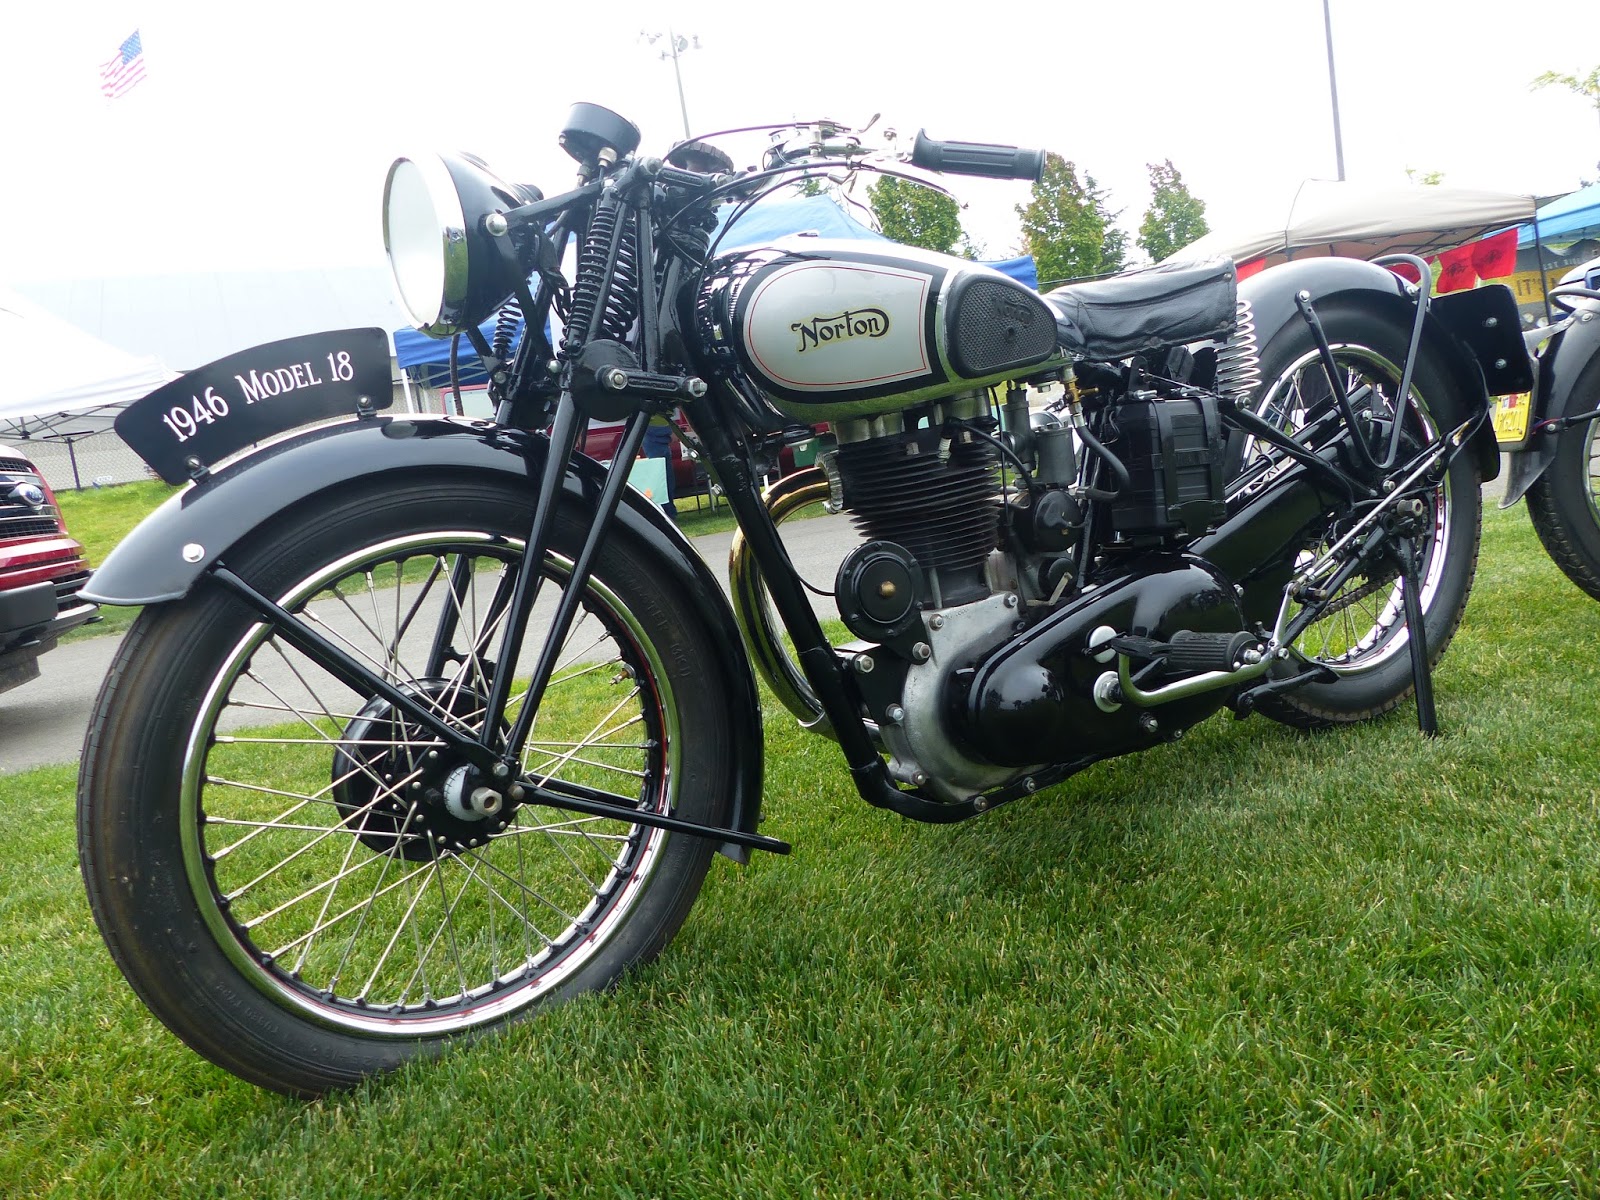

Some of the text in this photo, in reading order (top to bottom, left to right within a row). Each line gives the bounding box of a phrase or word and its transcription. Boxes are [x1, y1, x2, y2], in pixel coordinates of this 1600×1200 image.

[791, 308, 889, 352] Norton
[163, 386, 229, 442] 1946
[327, 351, 354, 382] 18
